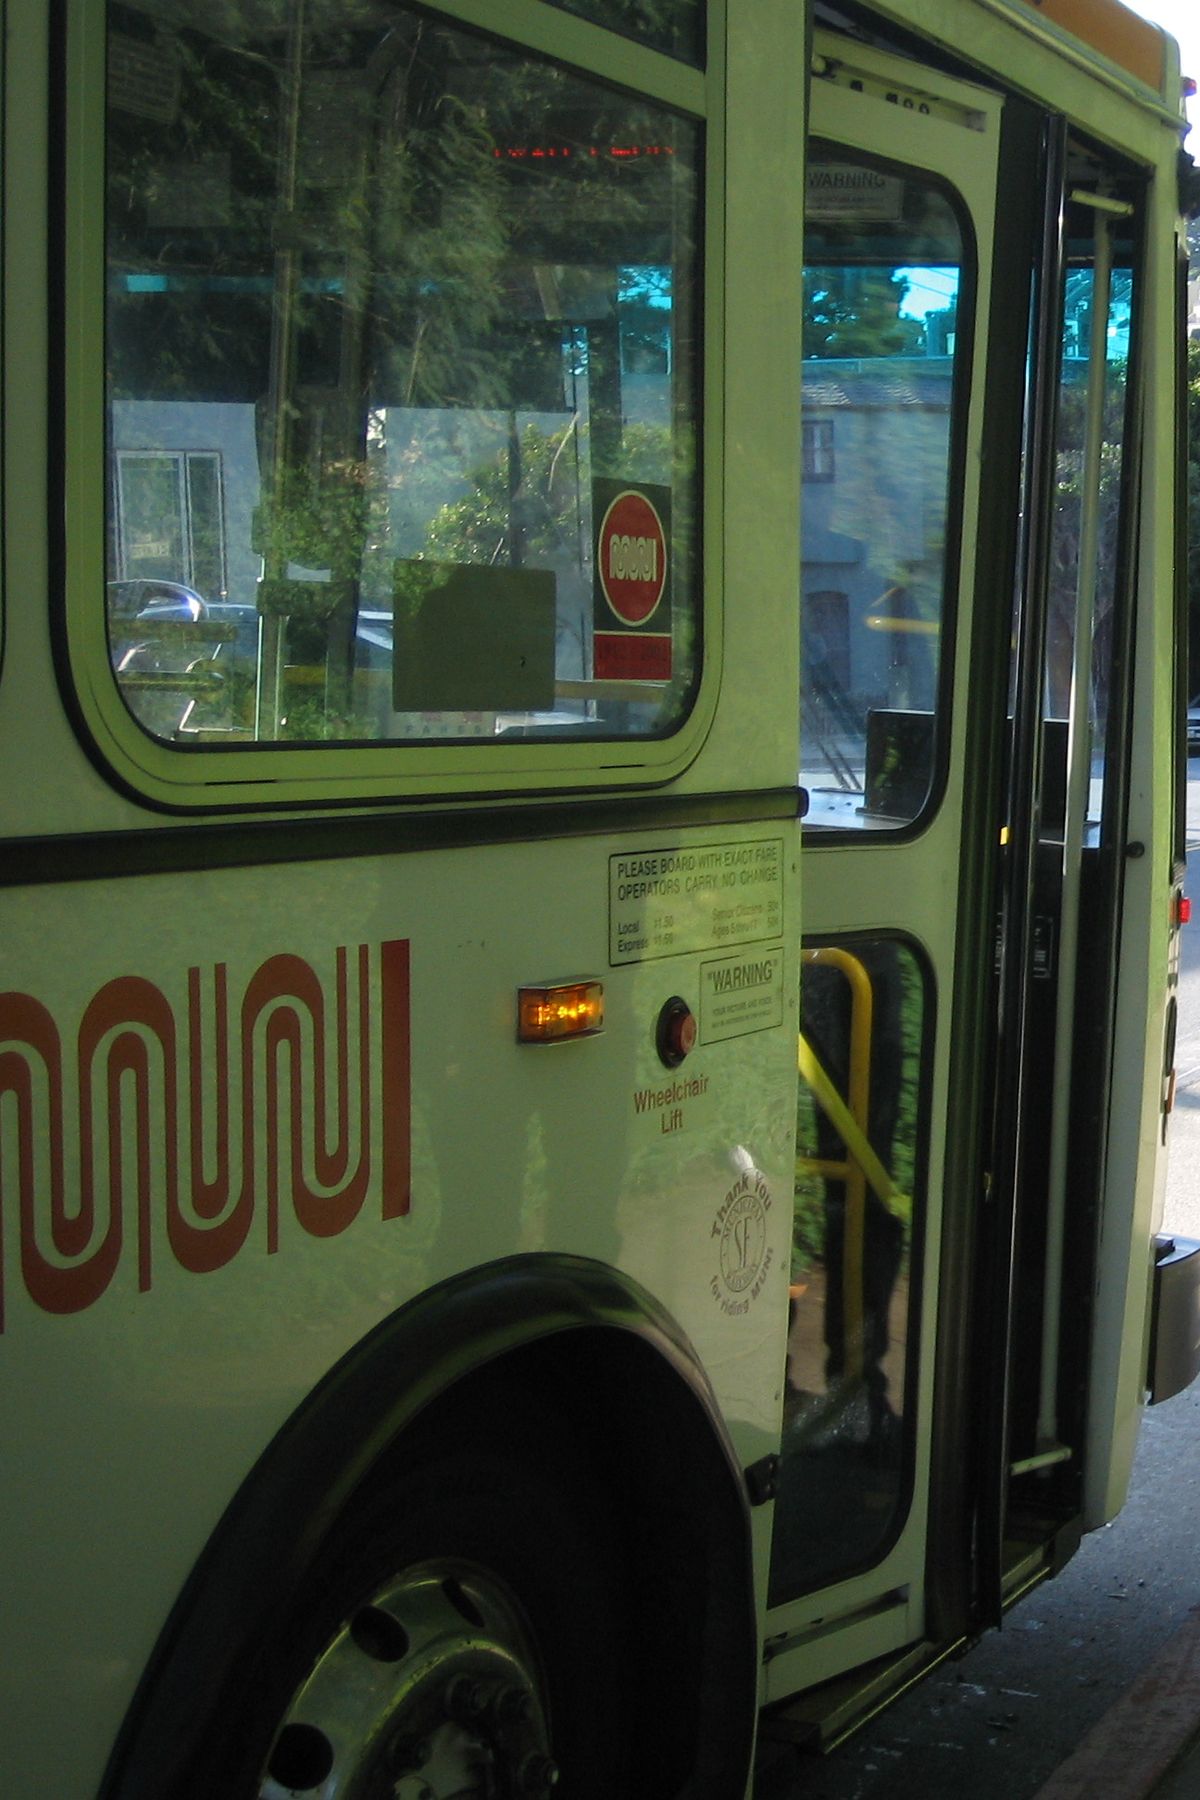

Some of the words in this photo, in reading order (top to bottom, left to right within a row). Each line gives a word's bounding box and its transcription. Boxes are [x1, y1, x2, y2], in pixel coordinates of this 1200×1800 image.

[618, 858, 658, 879] PLEASE
[660, 855, 695, 874] BOARD
[697, 851, 723, 869] WITH
[724, 849, 752, 867] EXACT
[754, 846, 778, 863] FARE
[617, 877, 680, 901] OPERATORS
[684, 873, 719, 894] CARRY
[720, 872, 737, 889] NO
[740, 865, 778, 885] CHANGE
[617, 920, 640, 936] Local
[617, 937, 649, 954] Express
[633, 1073, 710, 1113] Wheelchair
[660, 1113, 684, 1134] Lift
[710, 1172, 749, 1240] Thank
[754, 1172, 773, 1212] You
[750, 1245, 775, 1302] MUNI
